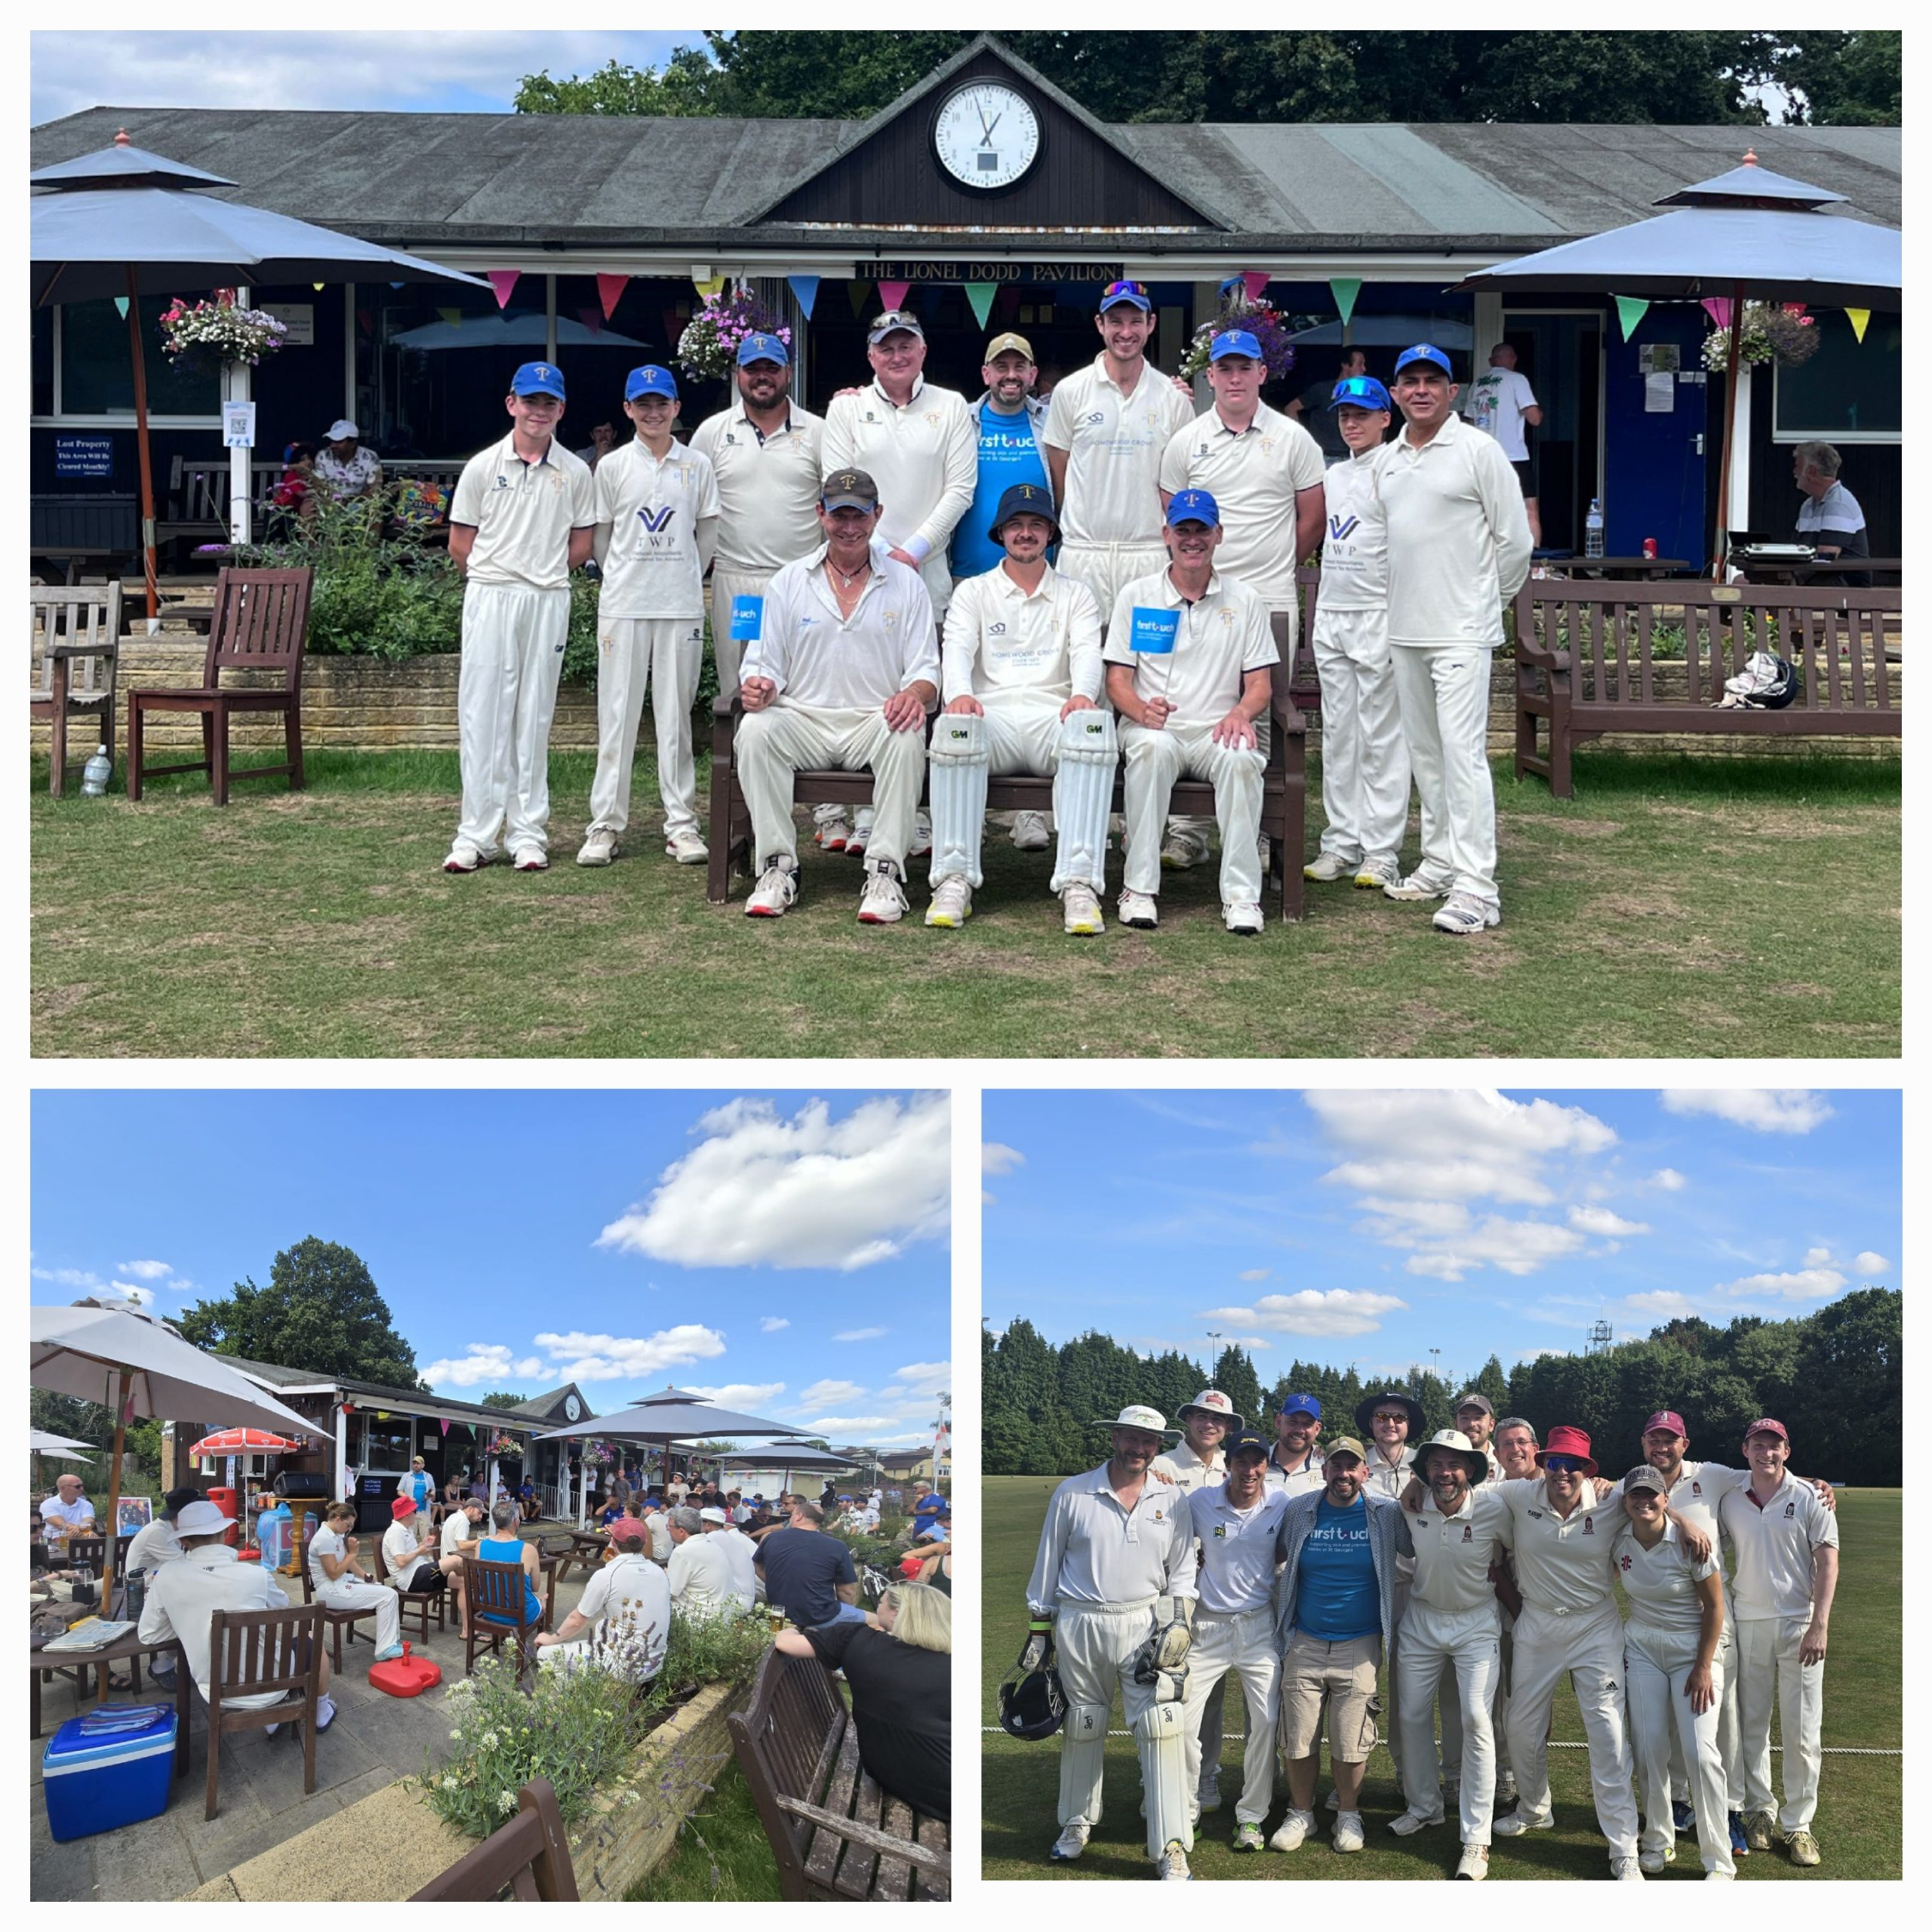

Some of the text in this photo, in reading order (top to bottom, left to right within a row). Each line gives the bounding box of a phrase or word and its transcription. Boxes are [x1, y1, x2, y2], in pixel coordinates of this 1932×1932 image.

[862, 263, 895, 278] THE
[904, 263, 962, 279] LIONEL
[969, 264, 1020, 280] DODD
[76, 440, 110, 450] Property
[978, 433, 999, 448] rst
[1087, 724, 1103, 734] GM
[951, 730, 968, 739] GM
